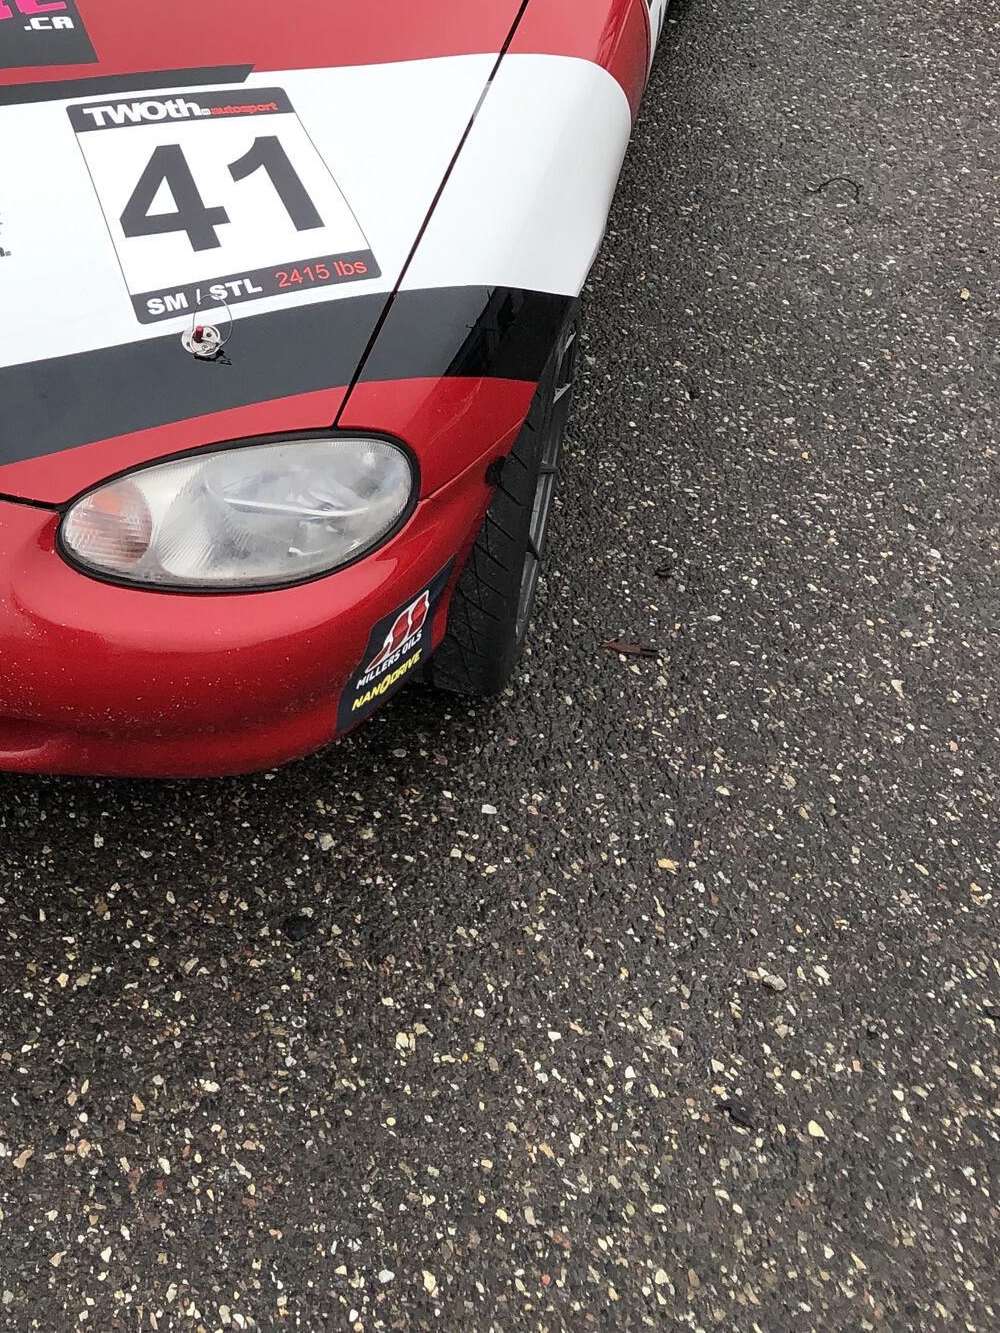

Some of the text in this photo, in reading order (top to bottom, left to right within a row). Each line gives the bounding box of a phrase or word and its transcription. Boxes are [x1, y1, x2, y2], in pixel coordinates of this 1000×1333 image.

[119, 135, 326, 253] 41
[146, 292, 188, 316] SM
[209, 278, 263, 301] STL
[275, 264, 330, 289] 2415
[333, 258, 368, 277] lbs
[352, 648, 423, 711] NANODRIVE
[356, 629, 423, 690] MILLERS OILS
